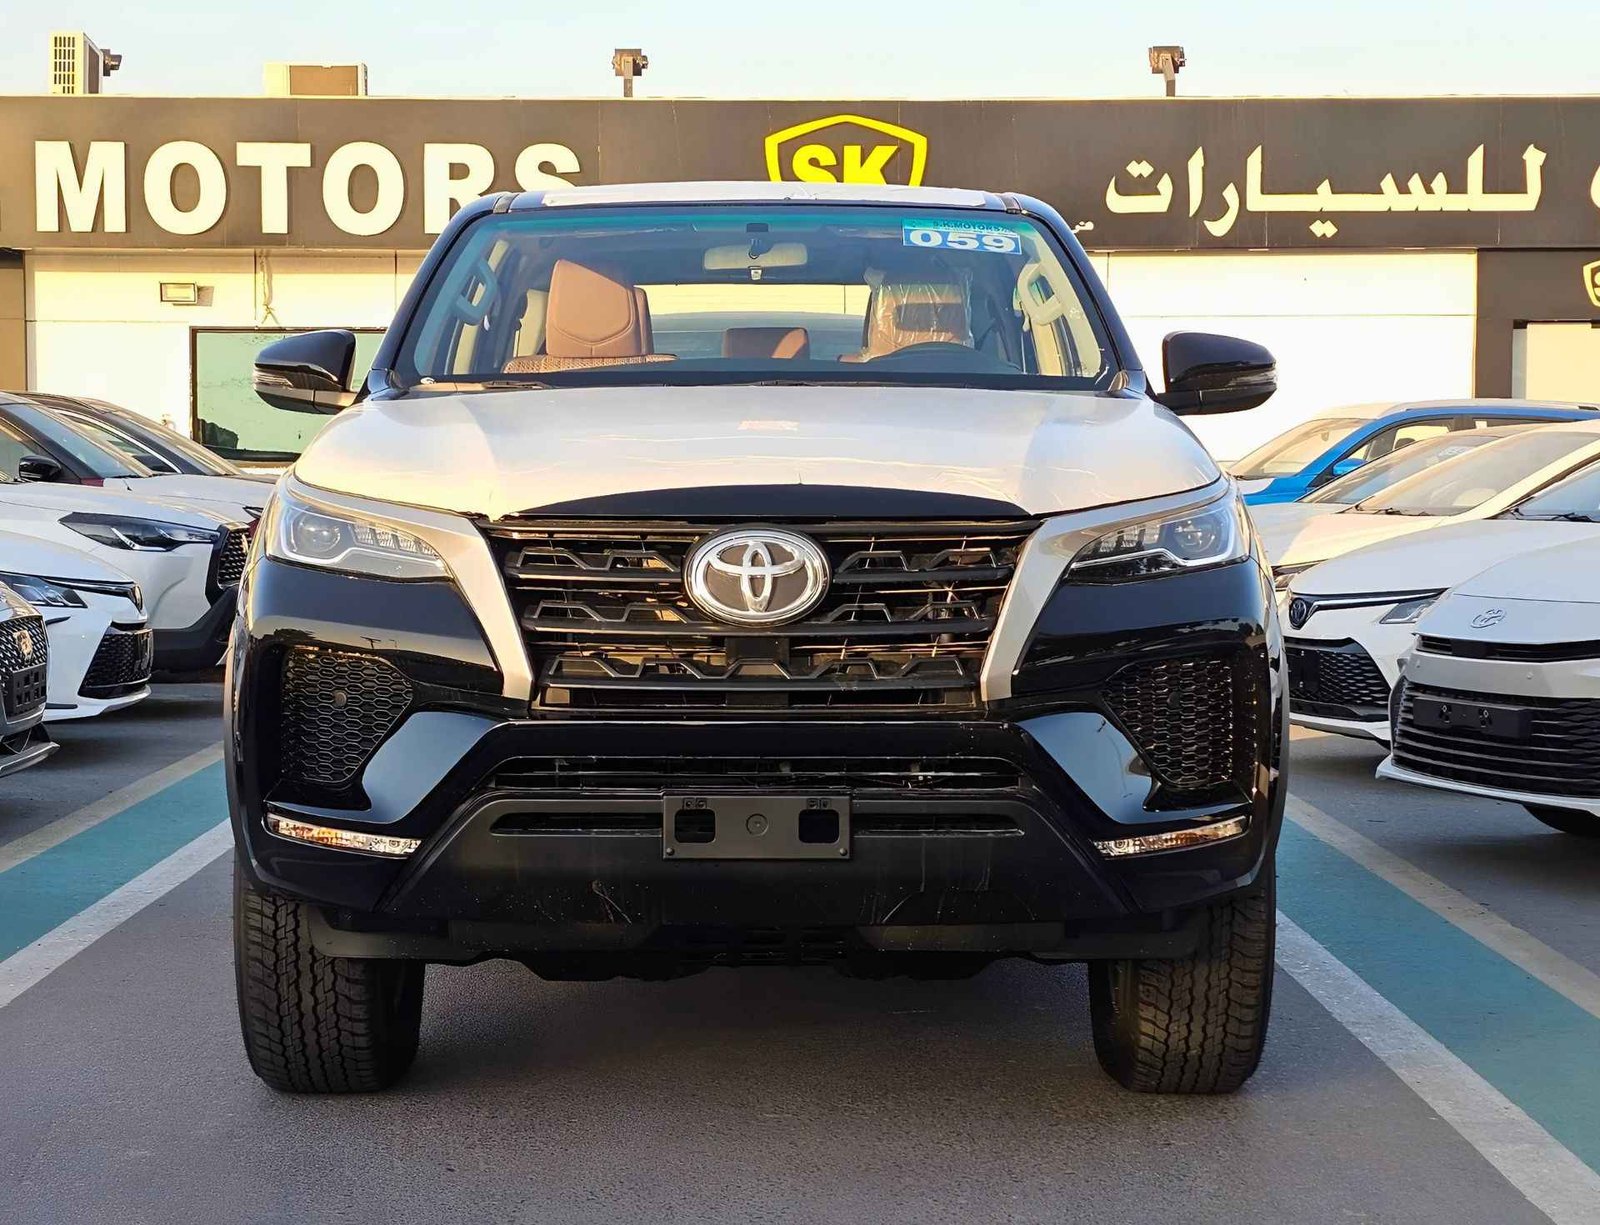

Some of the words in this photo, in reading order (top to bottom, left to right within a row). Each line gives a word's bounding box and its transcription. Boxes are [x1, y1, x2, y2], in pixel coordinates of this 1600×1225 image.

[34, 141, 581, 236] MOTORS
[792, 144, 899, 185] SK
[1105, 144, 1546, 238] للسيارات
[909, 229, 1016, 253] 059
